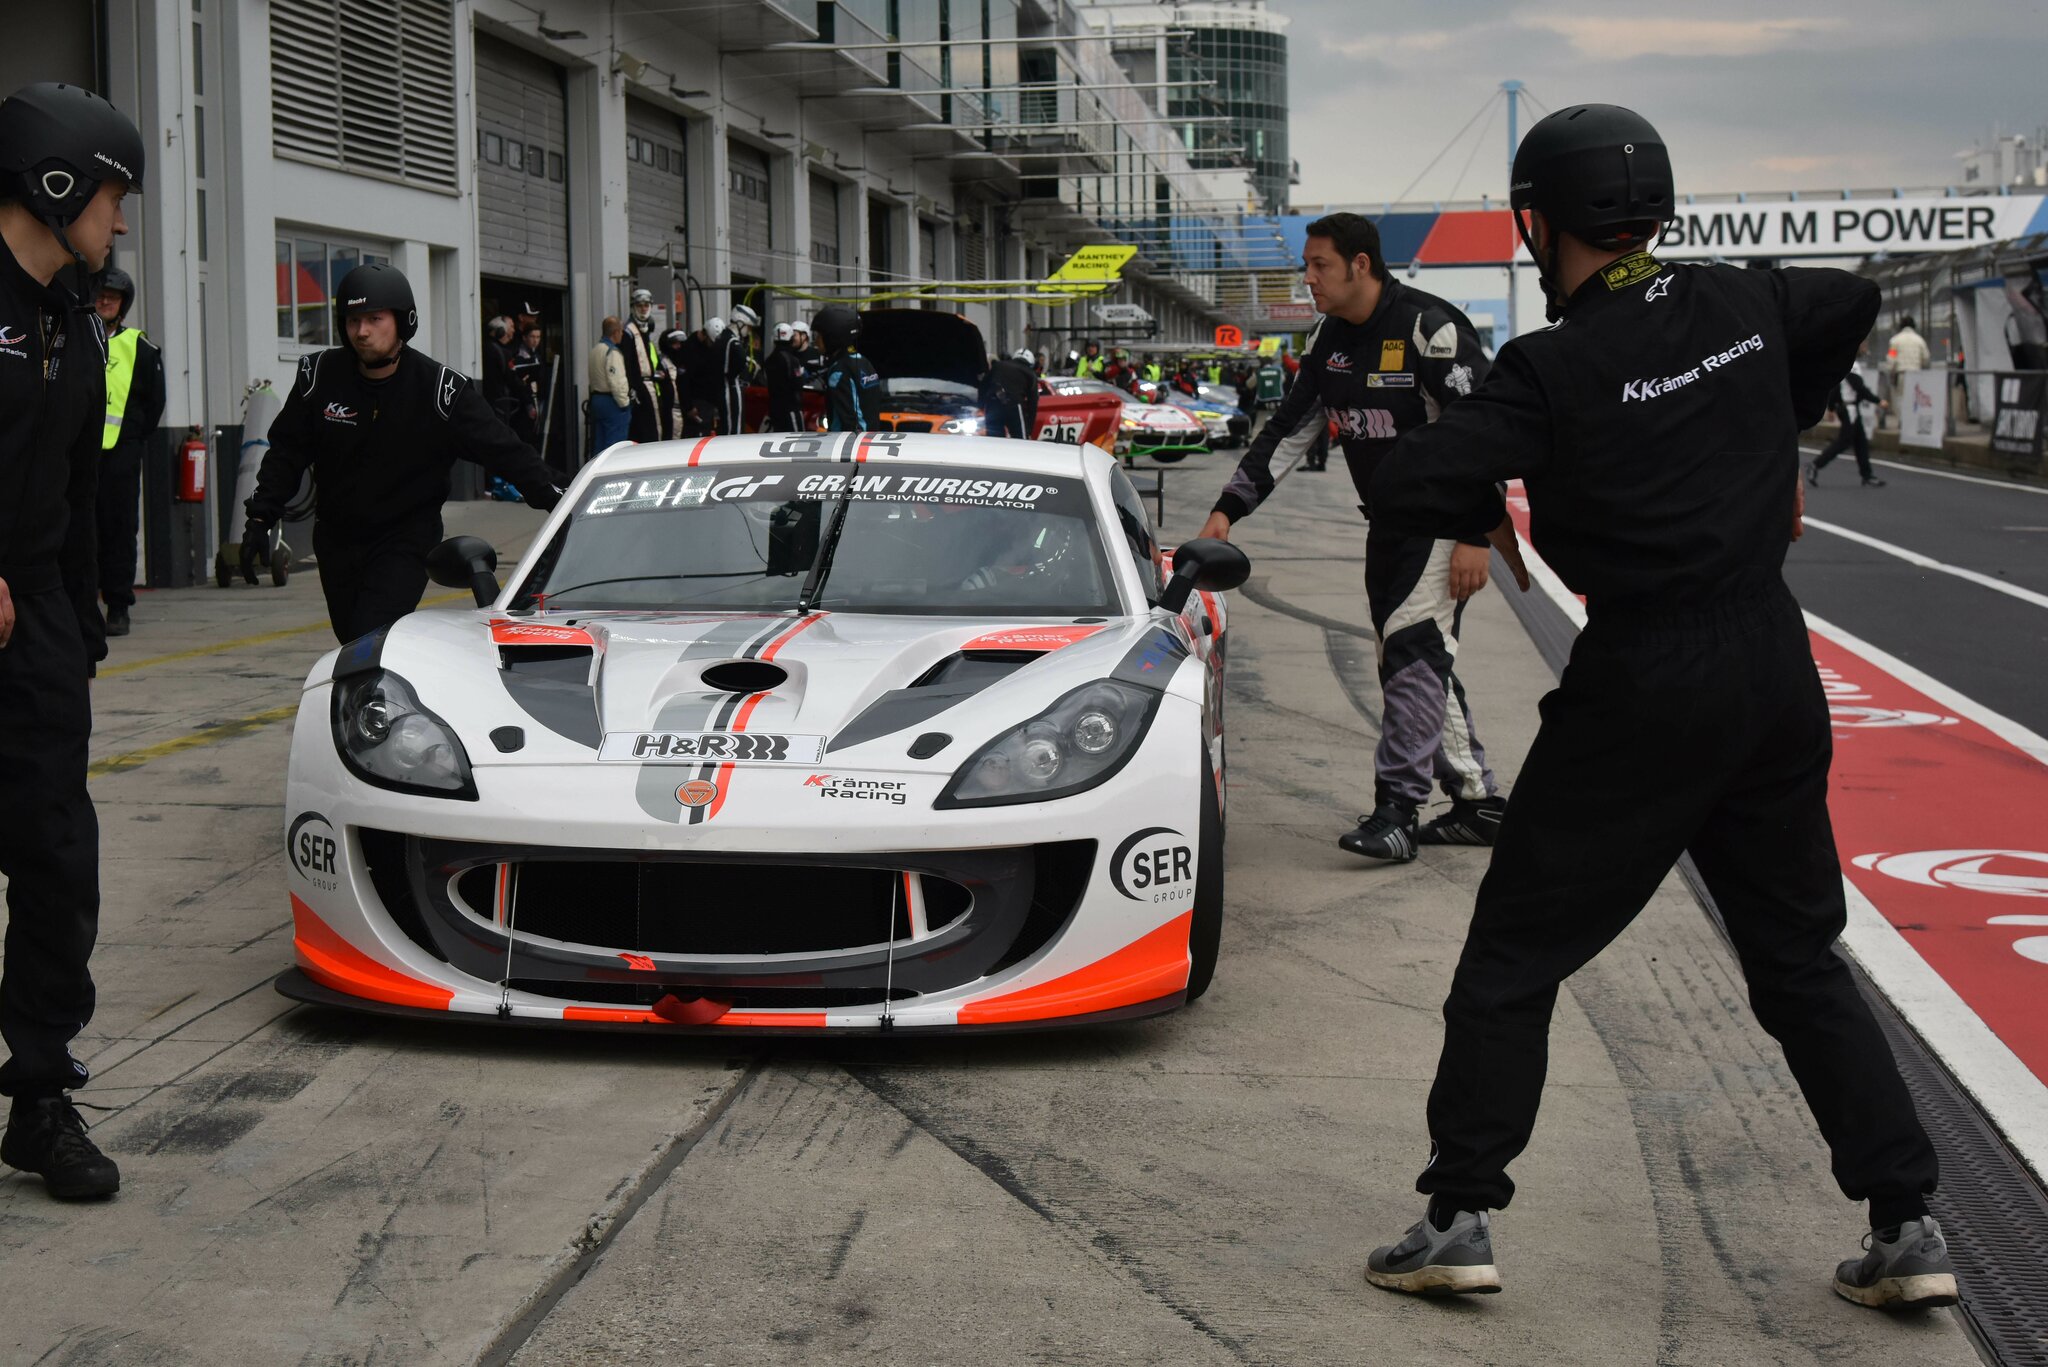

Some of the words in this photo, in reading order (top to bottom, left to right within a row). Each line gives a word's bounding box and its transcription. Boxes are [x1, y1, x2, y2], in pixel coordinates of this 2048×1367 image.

[1661, 212, 1767, 246] BMW
[1781, 211, 1817, 243] M
[1833, 206, 1995, 243] POWER
[6, 347, 28, 359] Racing
[1383, 342, 1405, 351] ADAC
[1702, 334, 1764, 372] Racing
[326, 402, 350, 418] KK
[797, 474, 893, 493] GRAN
[586, 476, 716, 514] 24H
[875, 494, 939, 503] DRIVING
[944, 497, 1035, 509] SIMULATOR
[632, 734, 740, 759] H&R
[803, 774, 907, 790] Krämer
[820, 787, 907, 806] Racing
[300, 832, 337, 875] SER
[1133, 846, 1192, 889] SER
[312, 877, 337, 891] GROUP
[1153, 888, 1192, 903] GROUP
